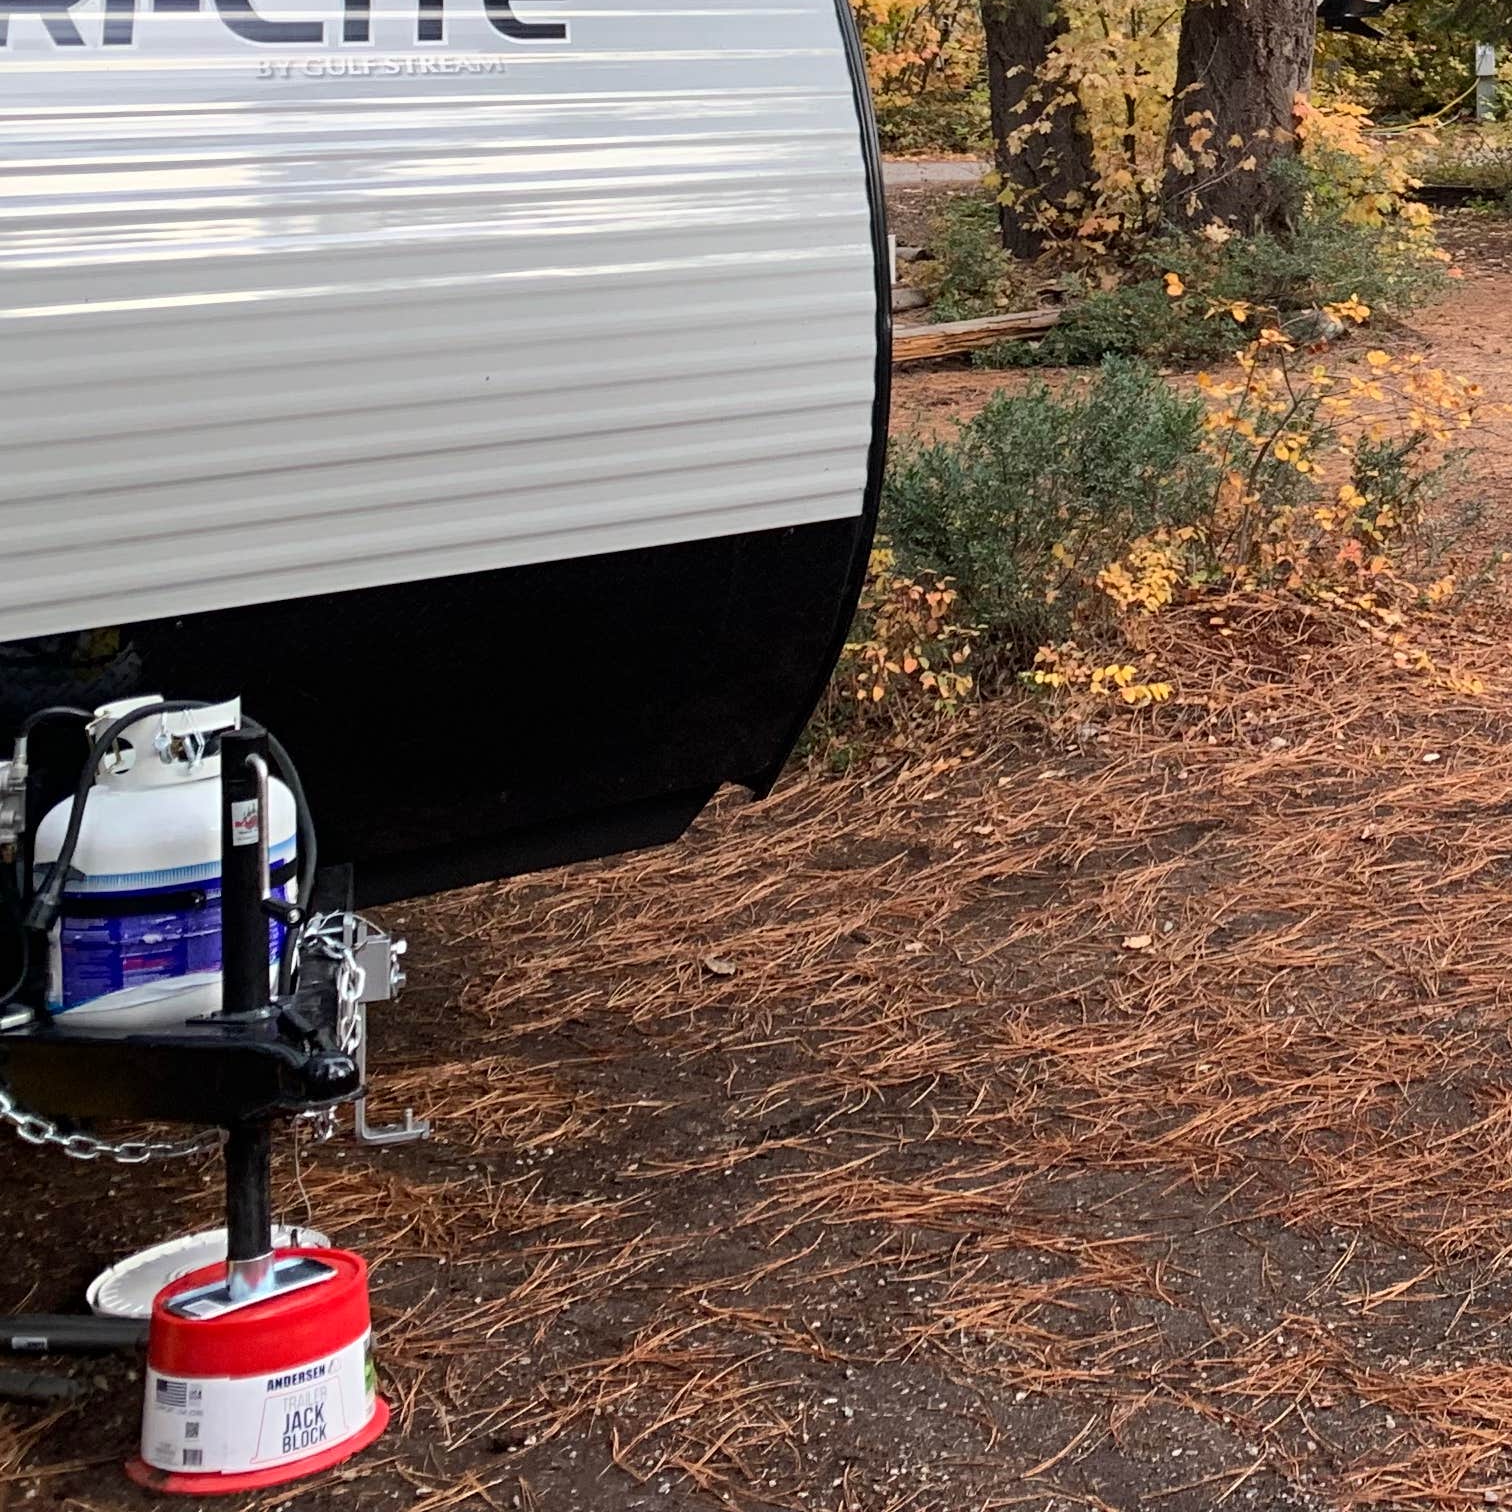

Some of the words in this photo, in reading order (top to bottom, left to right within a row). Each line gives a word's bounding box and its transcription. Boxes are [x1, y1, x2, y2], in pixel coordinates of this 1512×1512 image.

[256, 59, 294, 79] BY
[303, 56, 378, 78] GULF
[383, 55, 507, 76] STREAM
[266, 1364, 326, 1392] ANDERSEN
[282, 1386, 328, 1413] TRAILER
[282, 1402, 325, 1435] JACK
[282, 1423, 328, 1454] BLOCK
